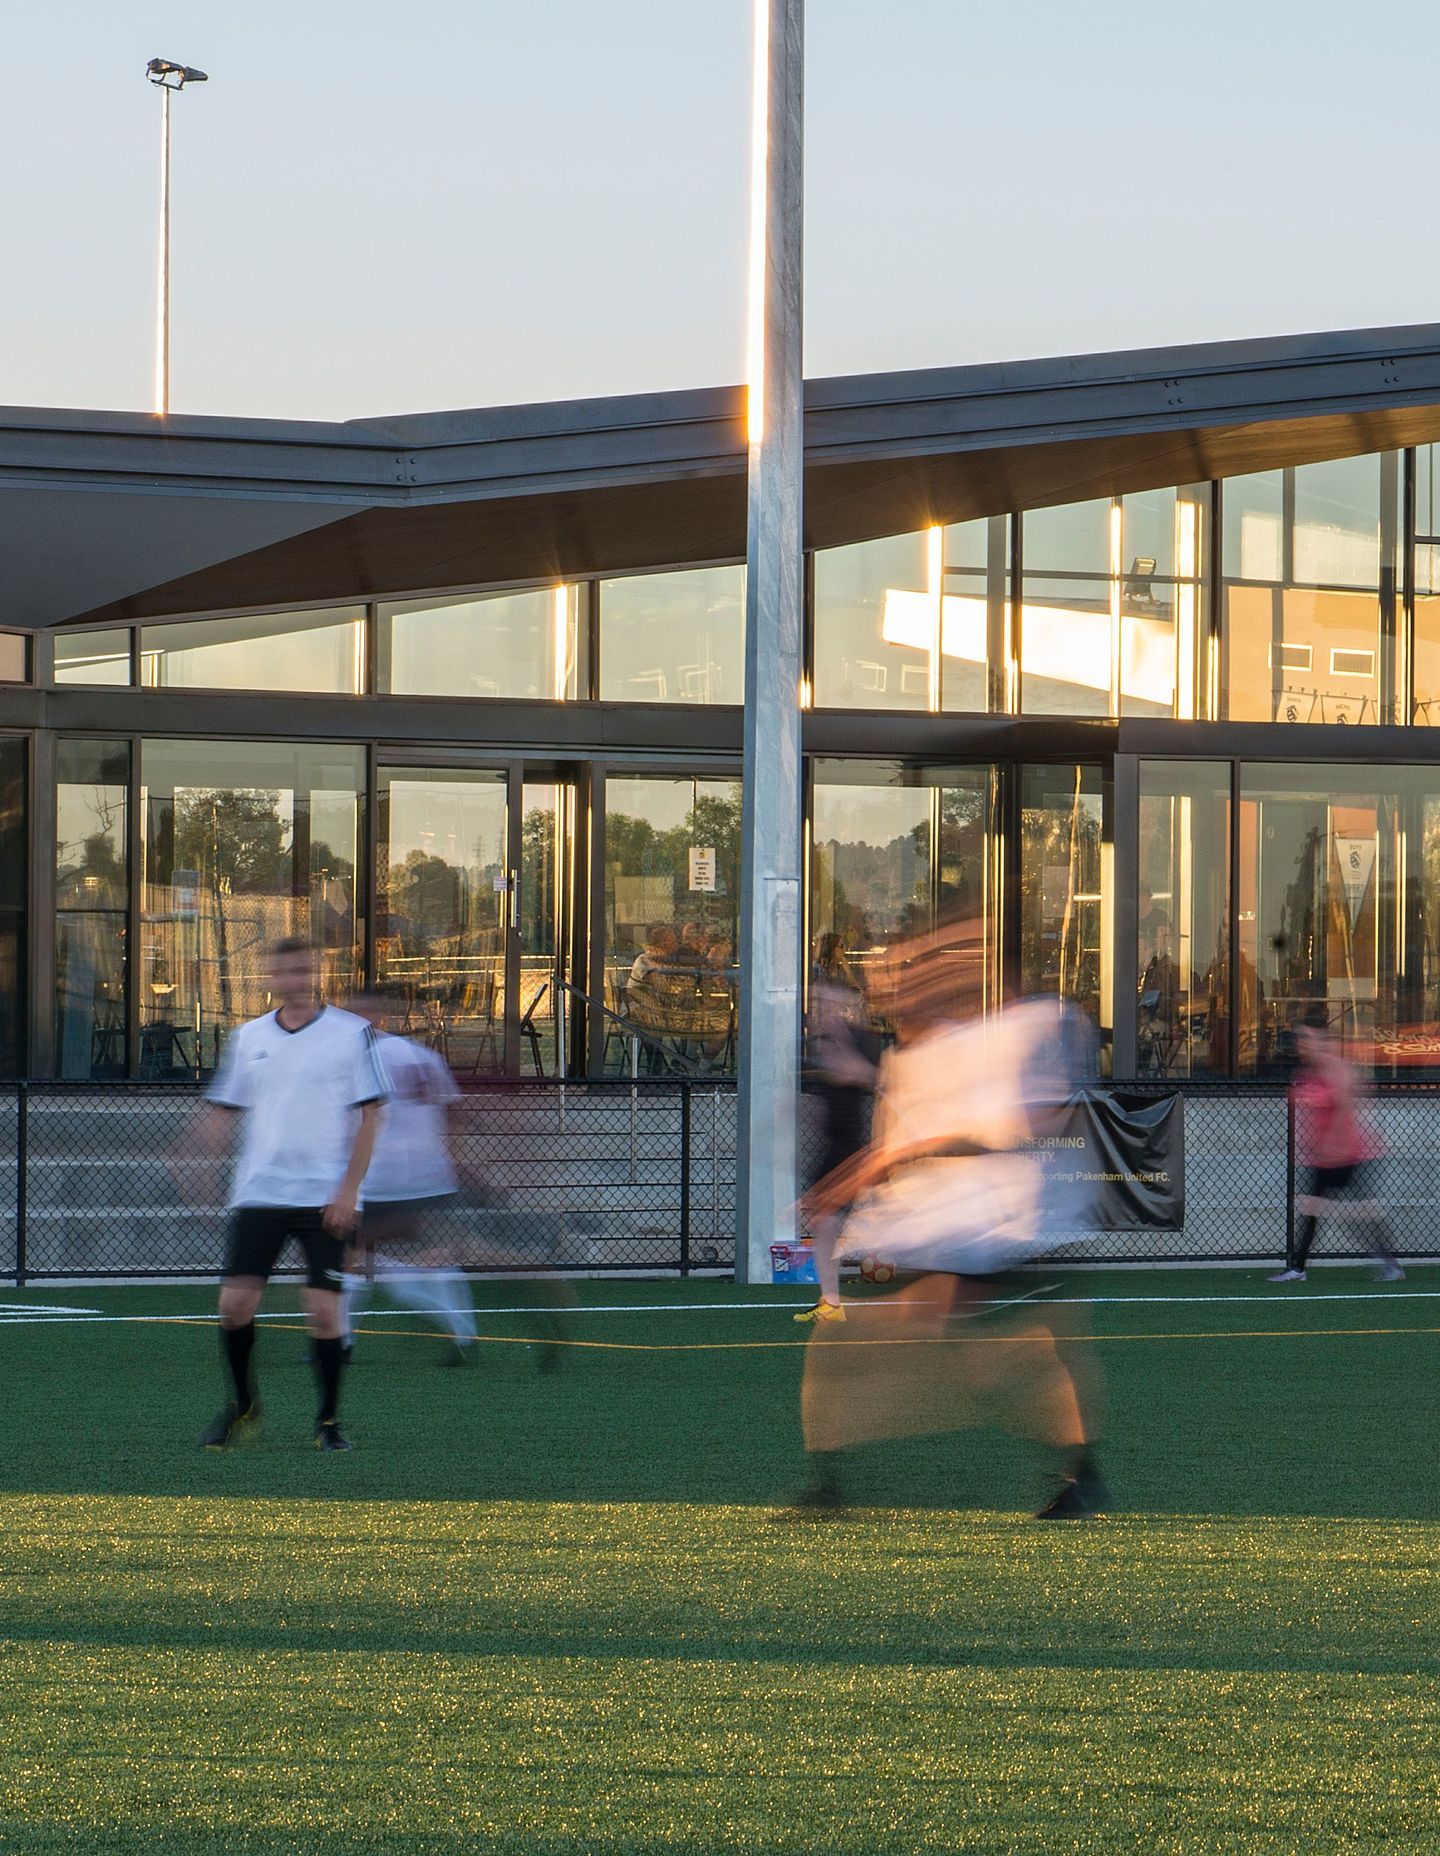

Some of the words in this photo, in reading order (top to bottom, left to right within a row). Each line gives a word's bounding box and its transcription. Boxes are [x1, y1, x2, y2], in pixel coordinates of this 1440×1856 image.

[1076, 1171, 1124, 1181] Pakenham
[1125, 1172, 1154, 1182] United
[1155, 1172, 1171, 1182] FC.
